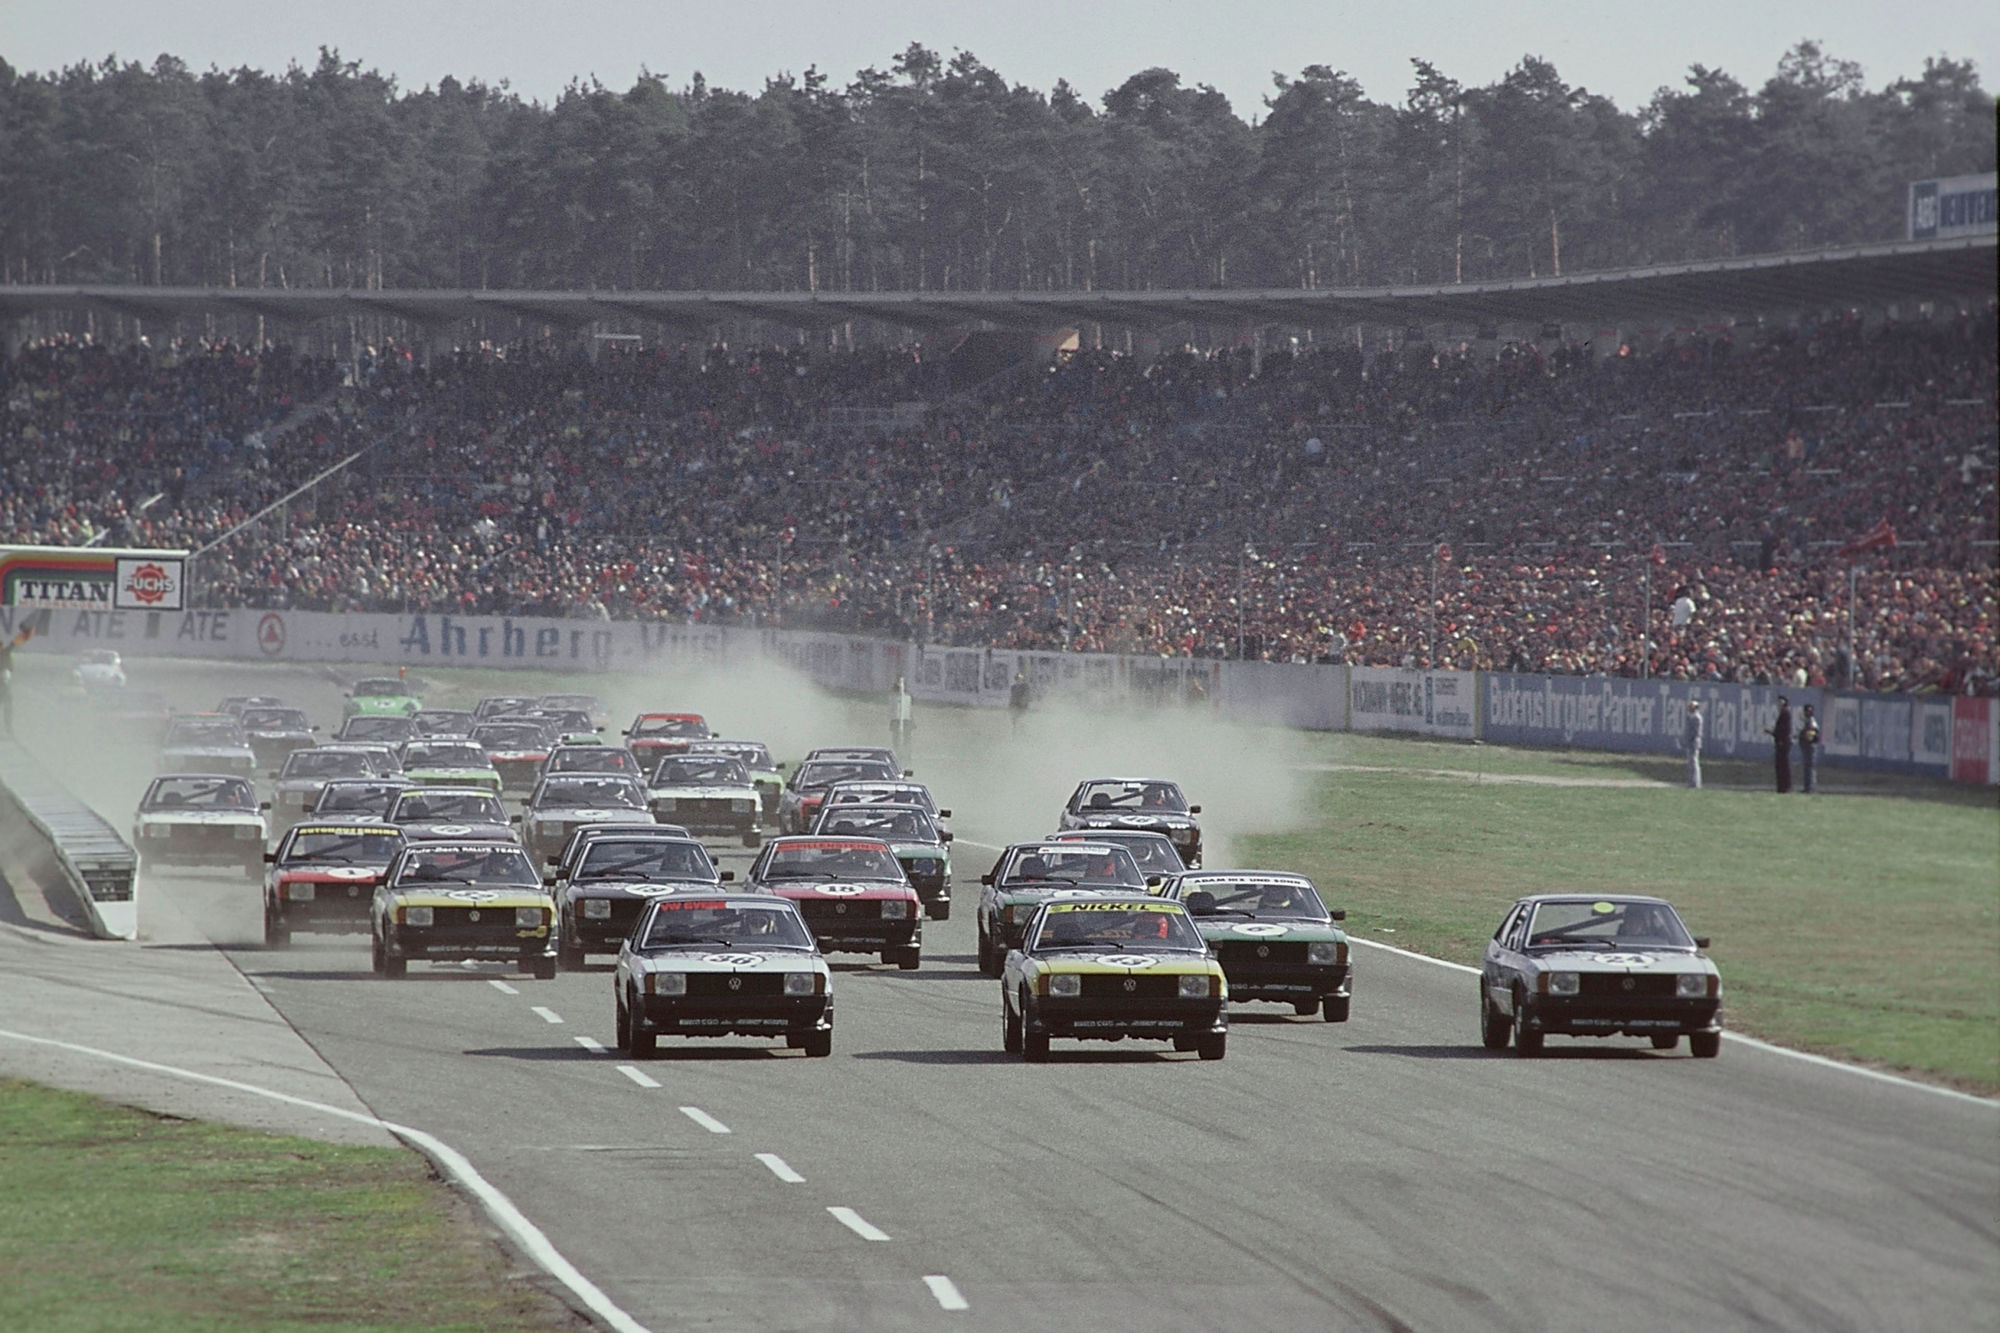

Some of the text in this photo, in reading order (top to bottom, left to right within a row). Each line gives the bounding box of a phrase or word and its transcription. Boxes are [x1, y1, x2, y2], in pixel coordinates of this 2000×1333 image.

[20, 580, 111, 602] TITAN
[124, 576, 176, 592] FUCHS
[73, 609, 125, 639] ATE
[178, 611, 230, 640] ATE
[1602, 682, 1655, 734] Partner
[1071, 903, 1150, 911] NICKEL
